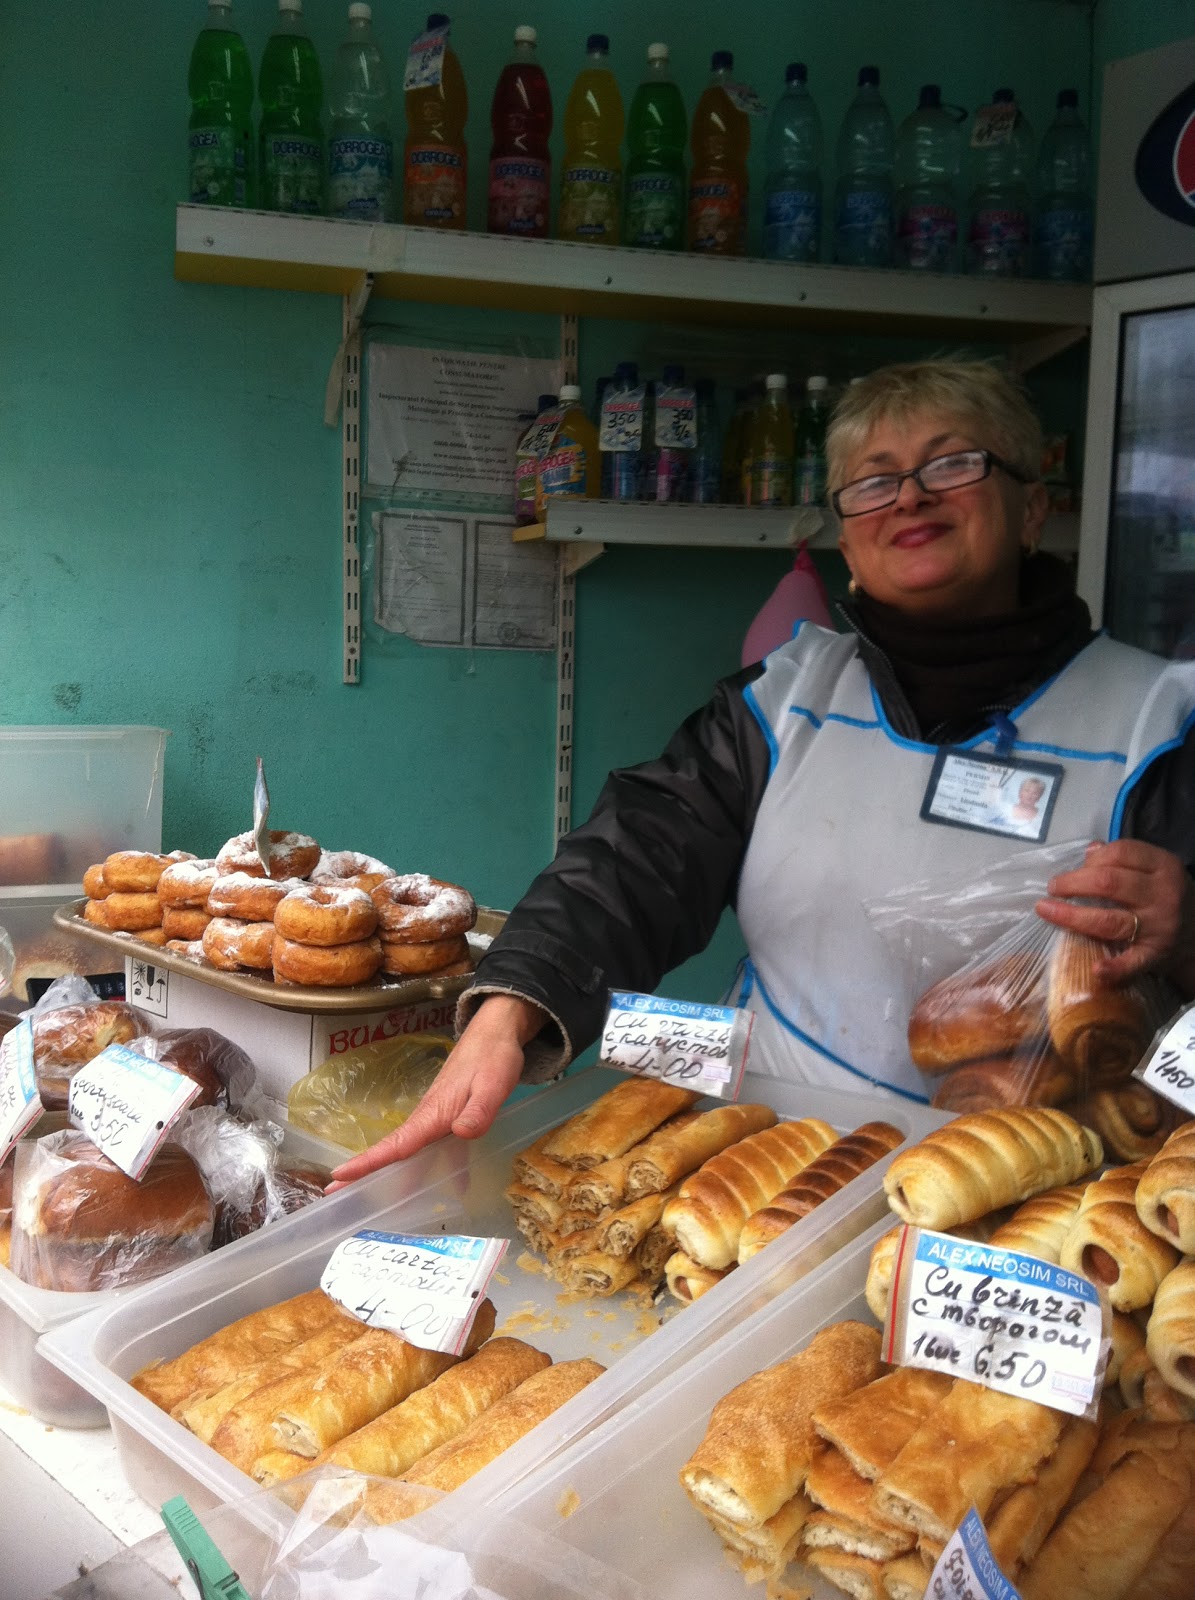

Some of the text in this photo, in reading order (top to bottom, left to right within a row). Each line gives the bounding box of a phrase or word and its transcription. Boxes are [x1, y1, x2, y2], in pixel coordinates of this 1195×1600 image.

[272, 140, 321, 158] DOBROGE
[618, 996, 727, 1020] ALEX NEOSIM SRL
[925, 1265, 963, 1300] Cu
[927, 1241, 1091, 1297] ALEX NEOSIM SRL
